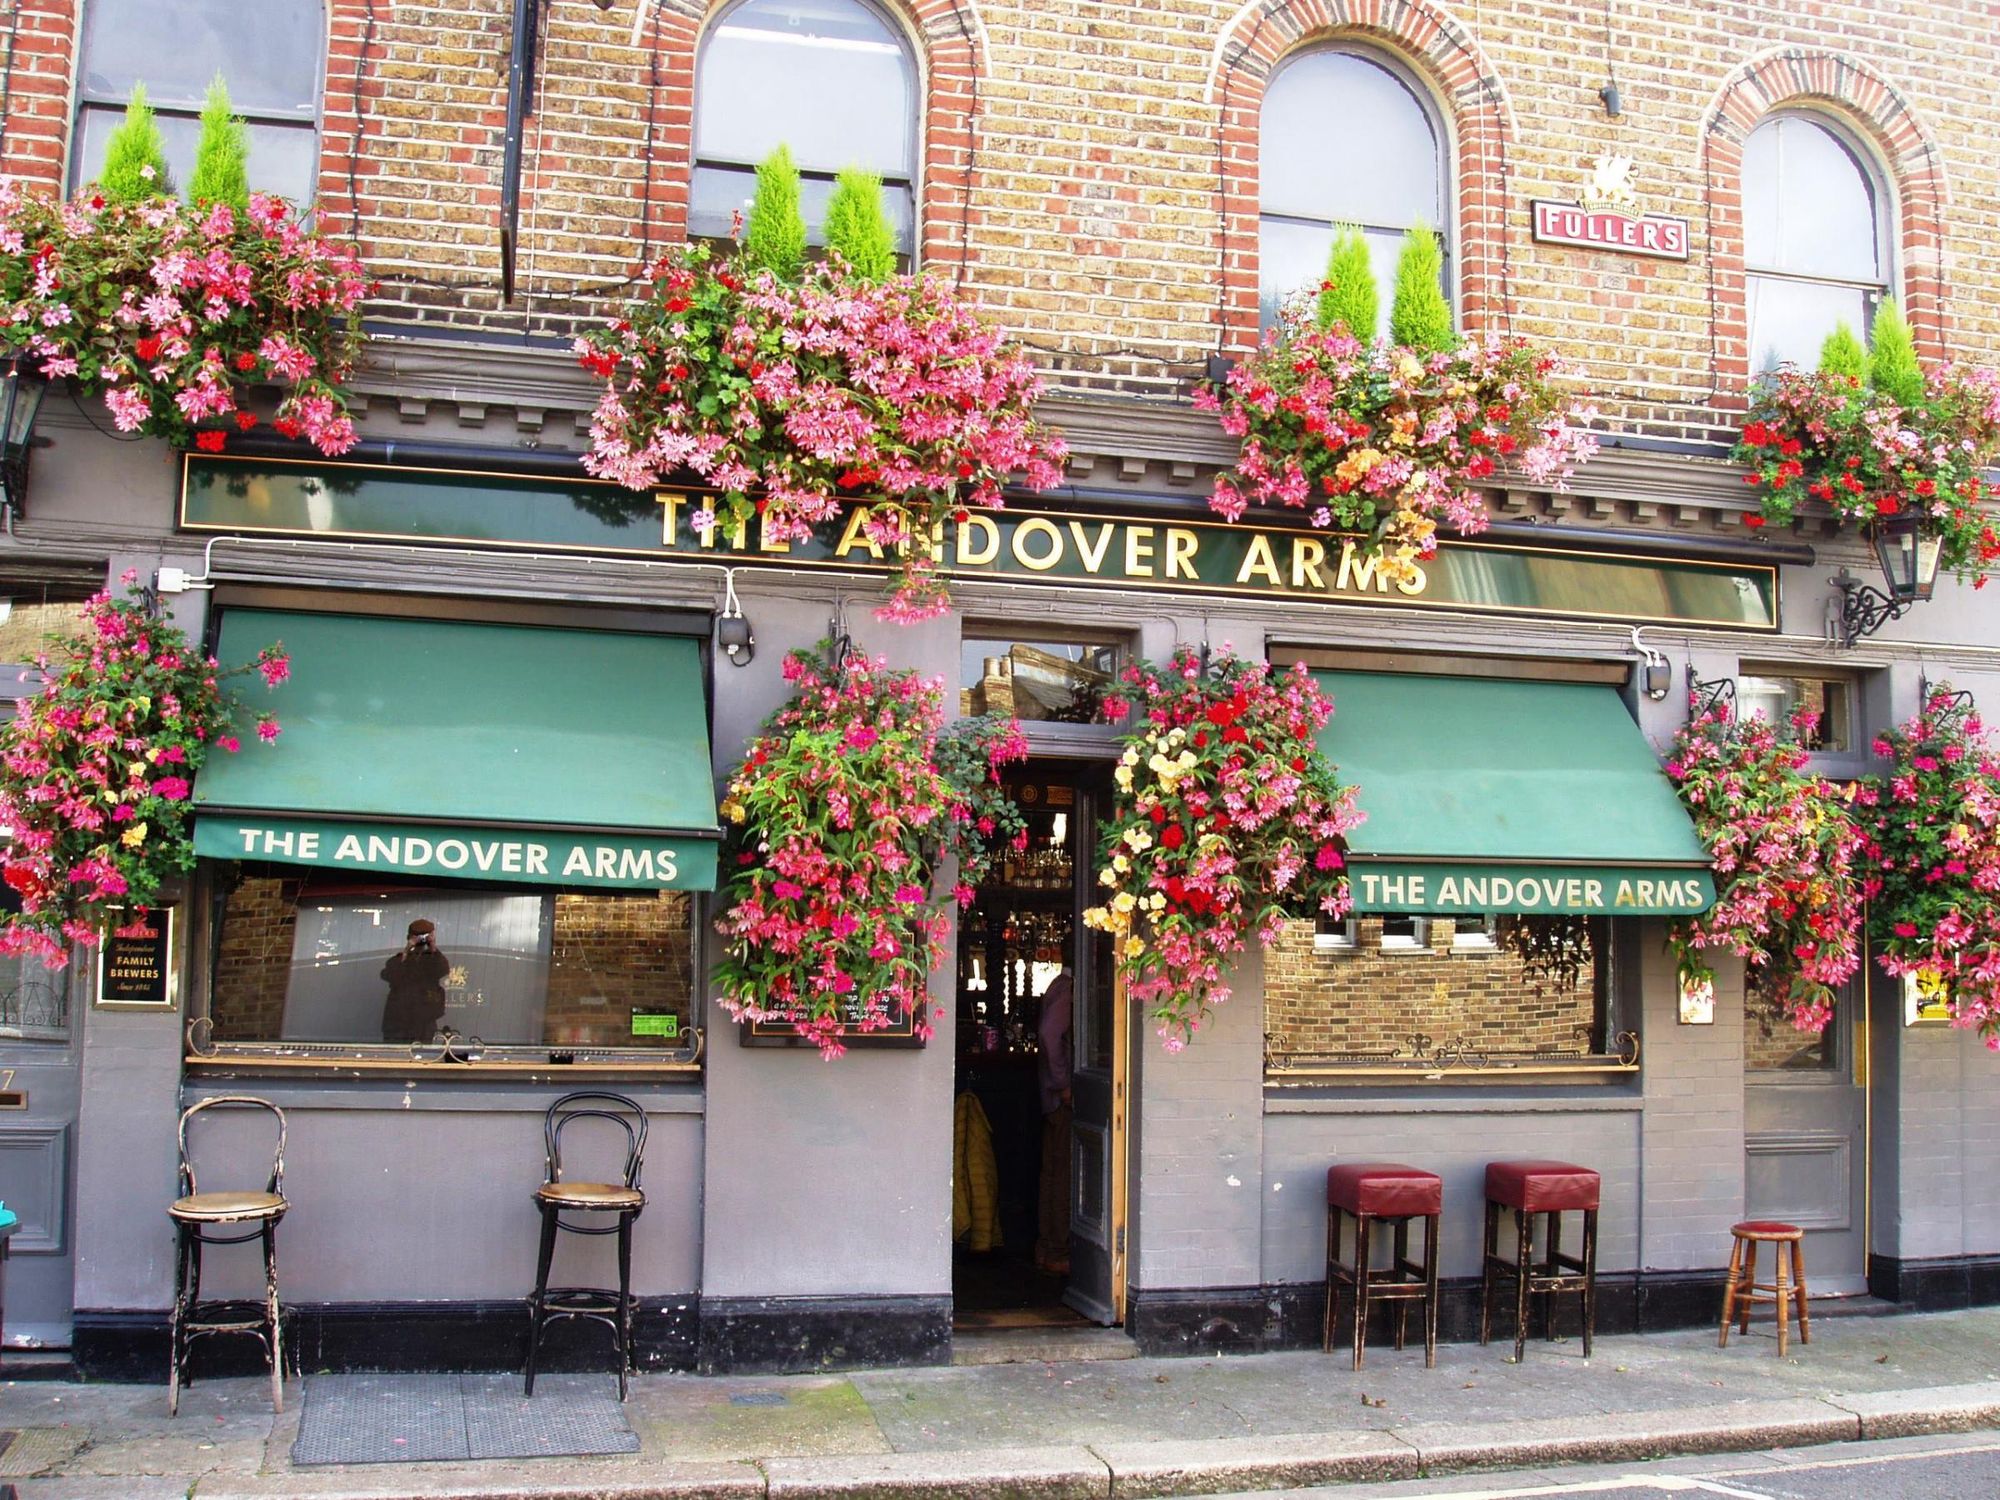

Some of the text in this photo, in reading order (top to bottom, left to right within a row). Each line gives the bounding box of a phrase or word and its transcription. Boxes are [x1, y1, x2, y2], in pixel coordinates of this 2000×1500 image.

[1545, 207, 1680, 251] FULLER'S
[239, 828, 678, 882] THE ANDOVER ARMS
[1360, 874, 1704, 908] THE ANDOVER ARMS
[110, 968, 159, 979] BREWERS
[116, 956, 154, 966] FAMILY
[2, 1070, 16, 1091] 7
